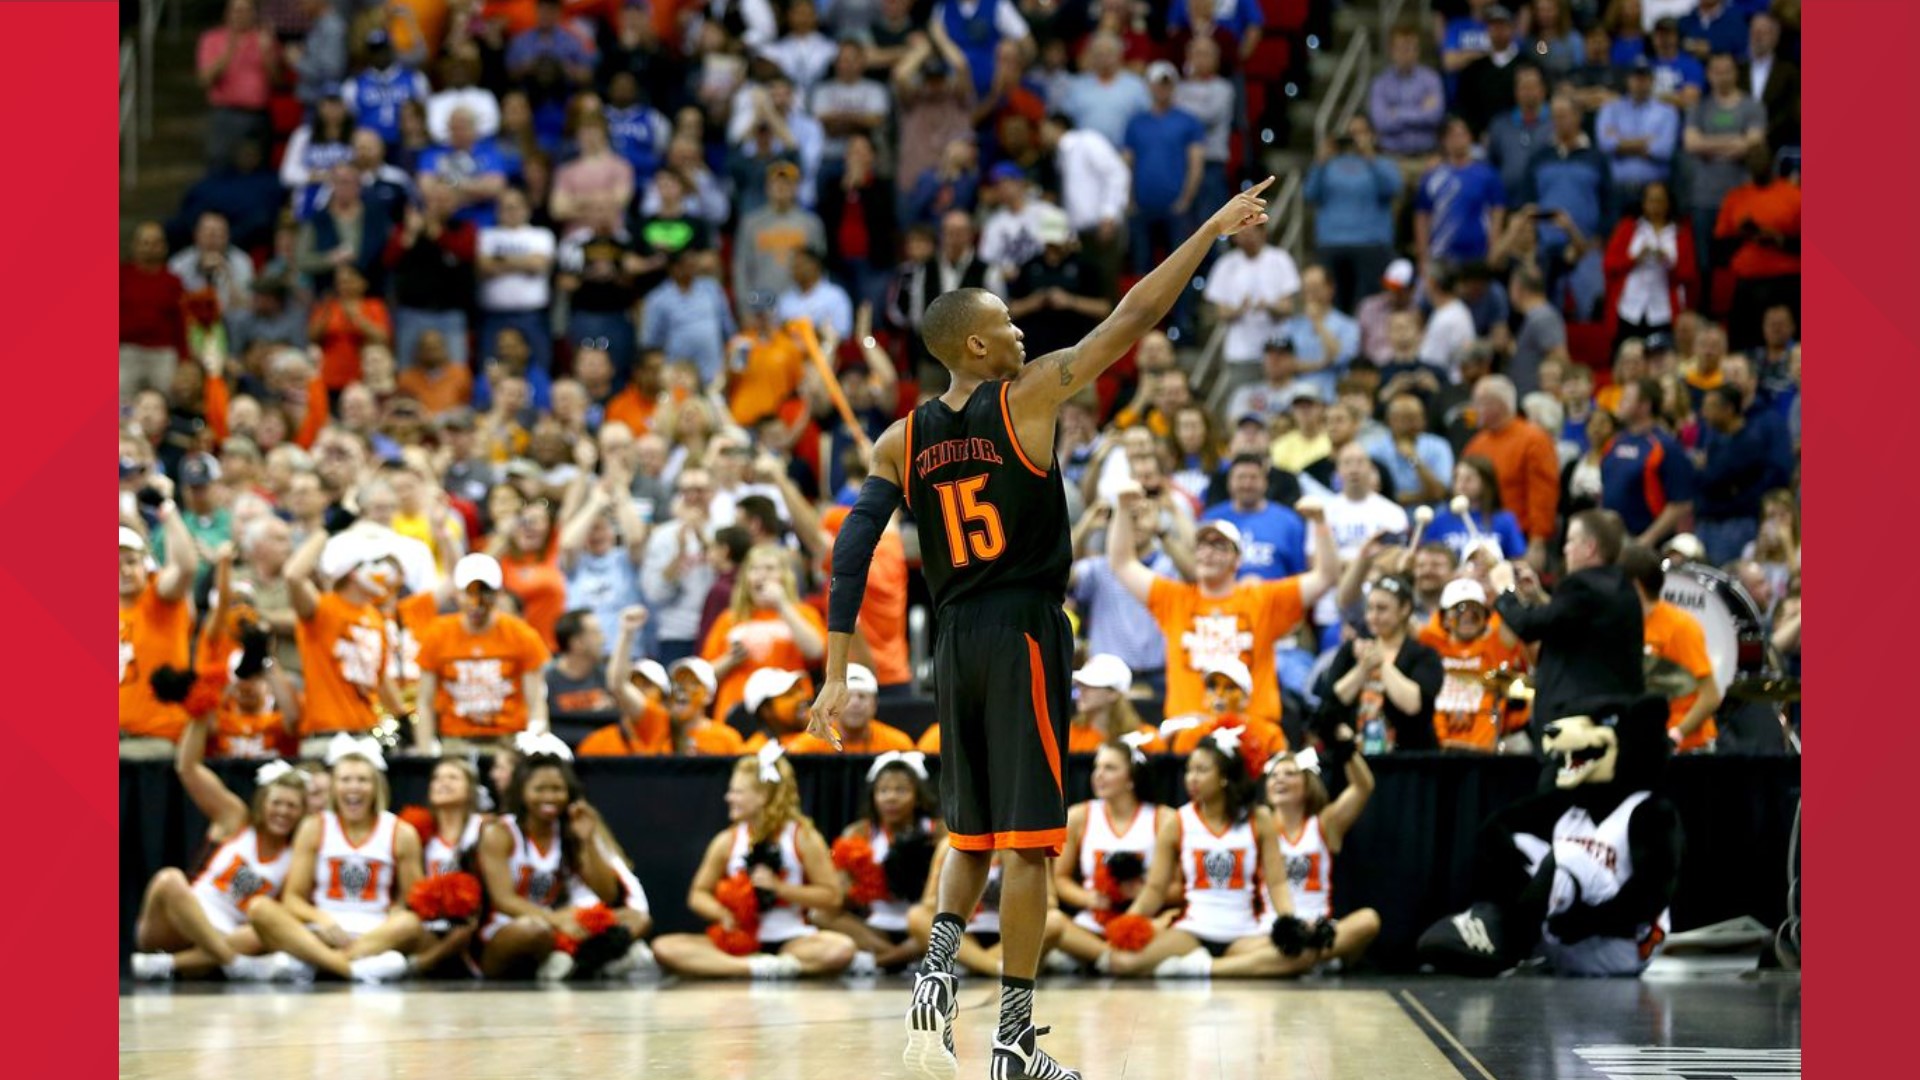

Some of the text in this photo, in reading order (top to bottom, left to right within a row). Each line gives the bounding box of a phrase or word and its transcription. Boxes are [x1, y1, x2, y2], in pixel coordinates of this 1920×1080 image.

[971, 437, 1003, 465] JR.
[933, 473, 1006, 568] 15
[1664, 590, 1706, 610] MAHA
